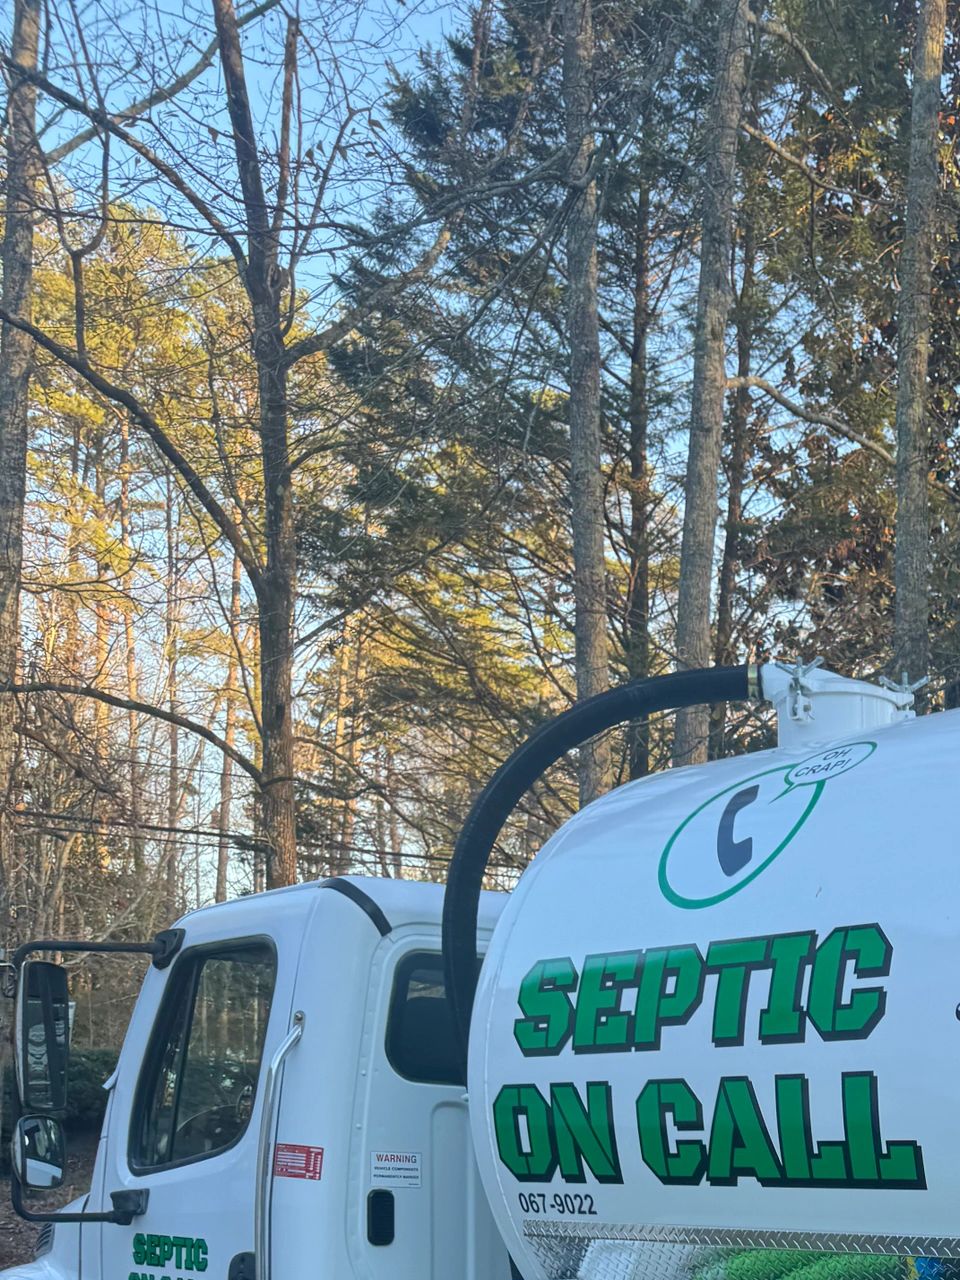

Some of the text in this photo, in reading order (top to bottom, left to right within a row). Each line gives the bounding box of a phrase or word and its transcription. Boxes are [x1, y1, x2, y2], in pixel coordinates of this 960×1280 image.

[822, 748, 853, 761] OH
[794, 758, 852, 777] CRAP!
[513, 922, 894, 1057] SEPTIC
[493, 1071, 928, 1190] ON CALL
[376, 1153, 417, 1164] WARNING
[518, 1192, 598, 1215] 067-9022
[133, 1232, 209, 1272] SEPTIC
